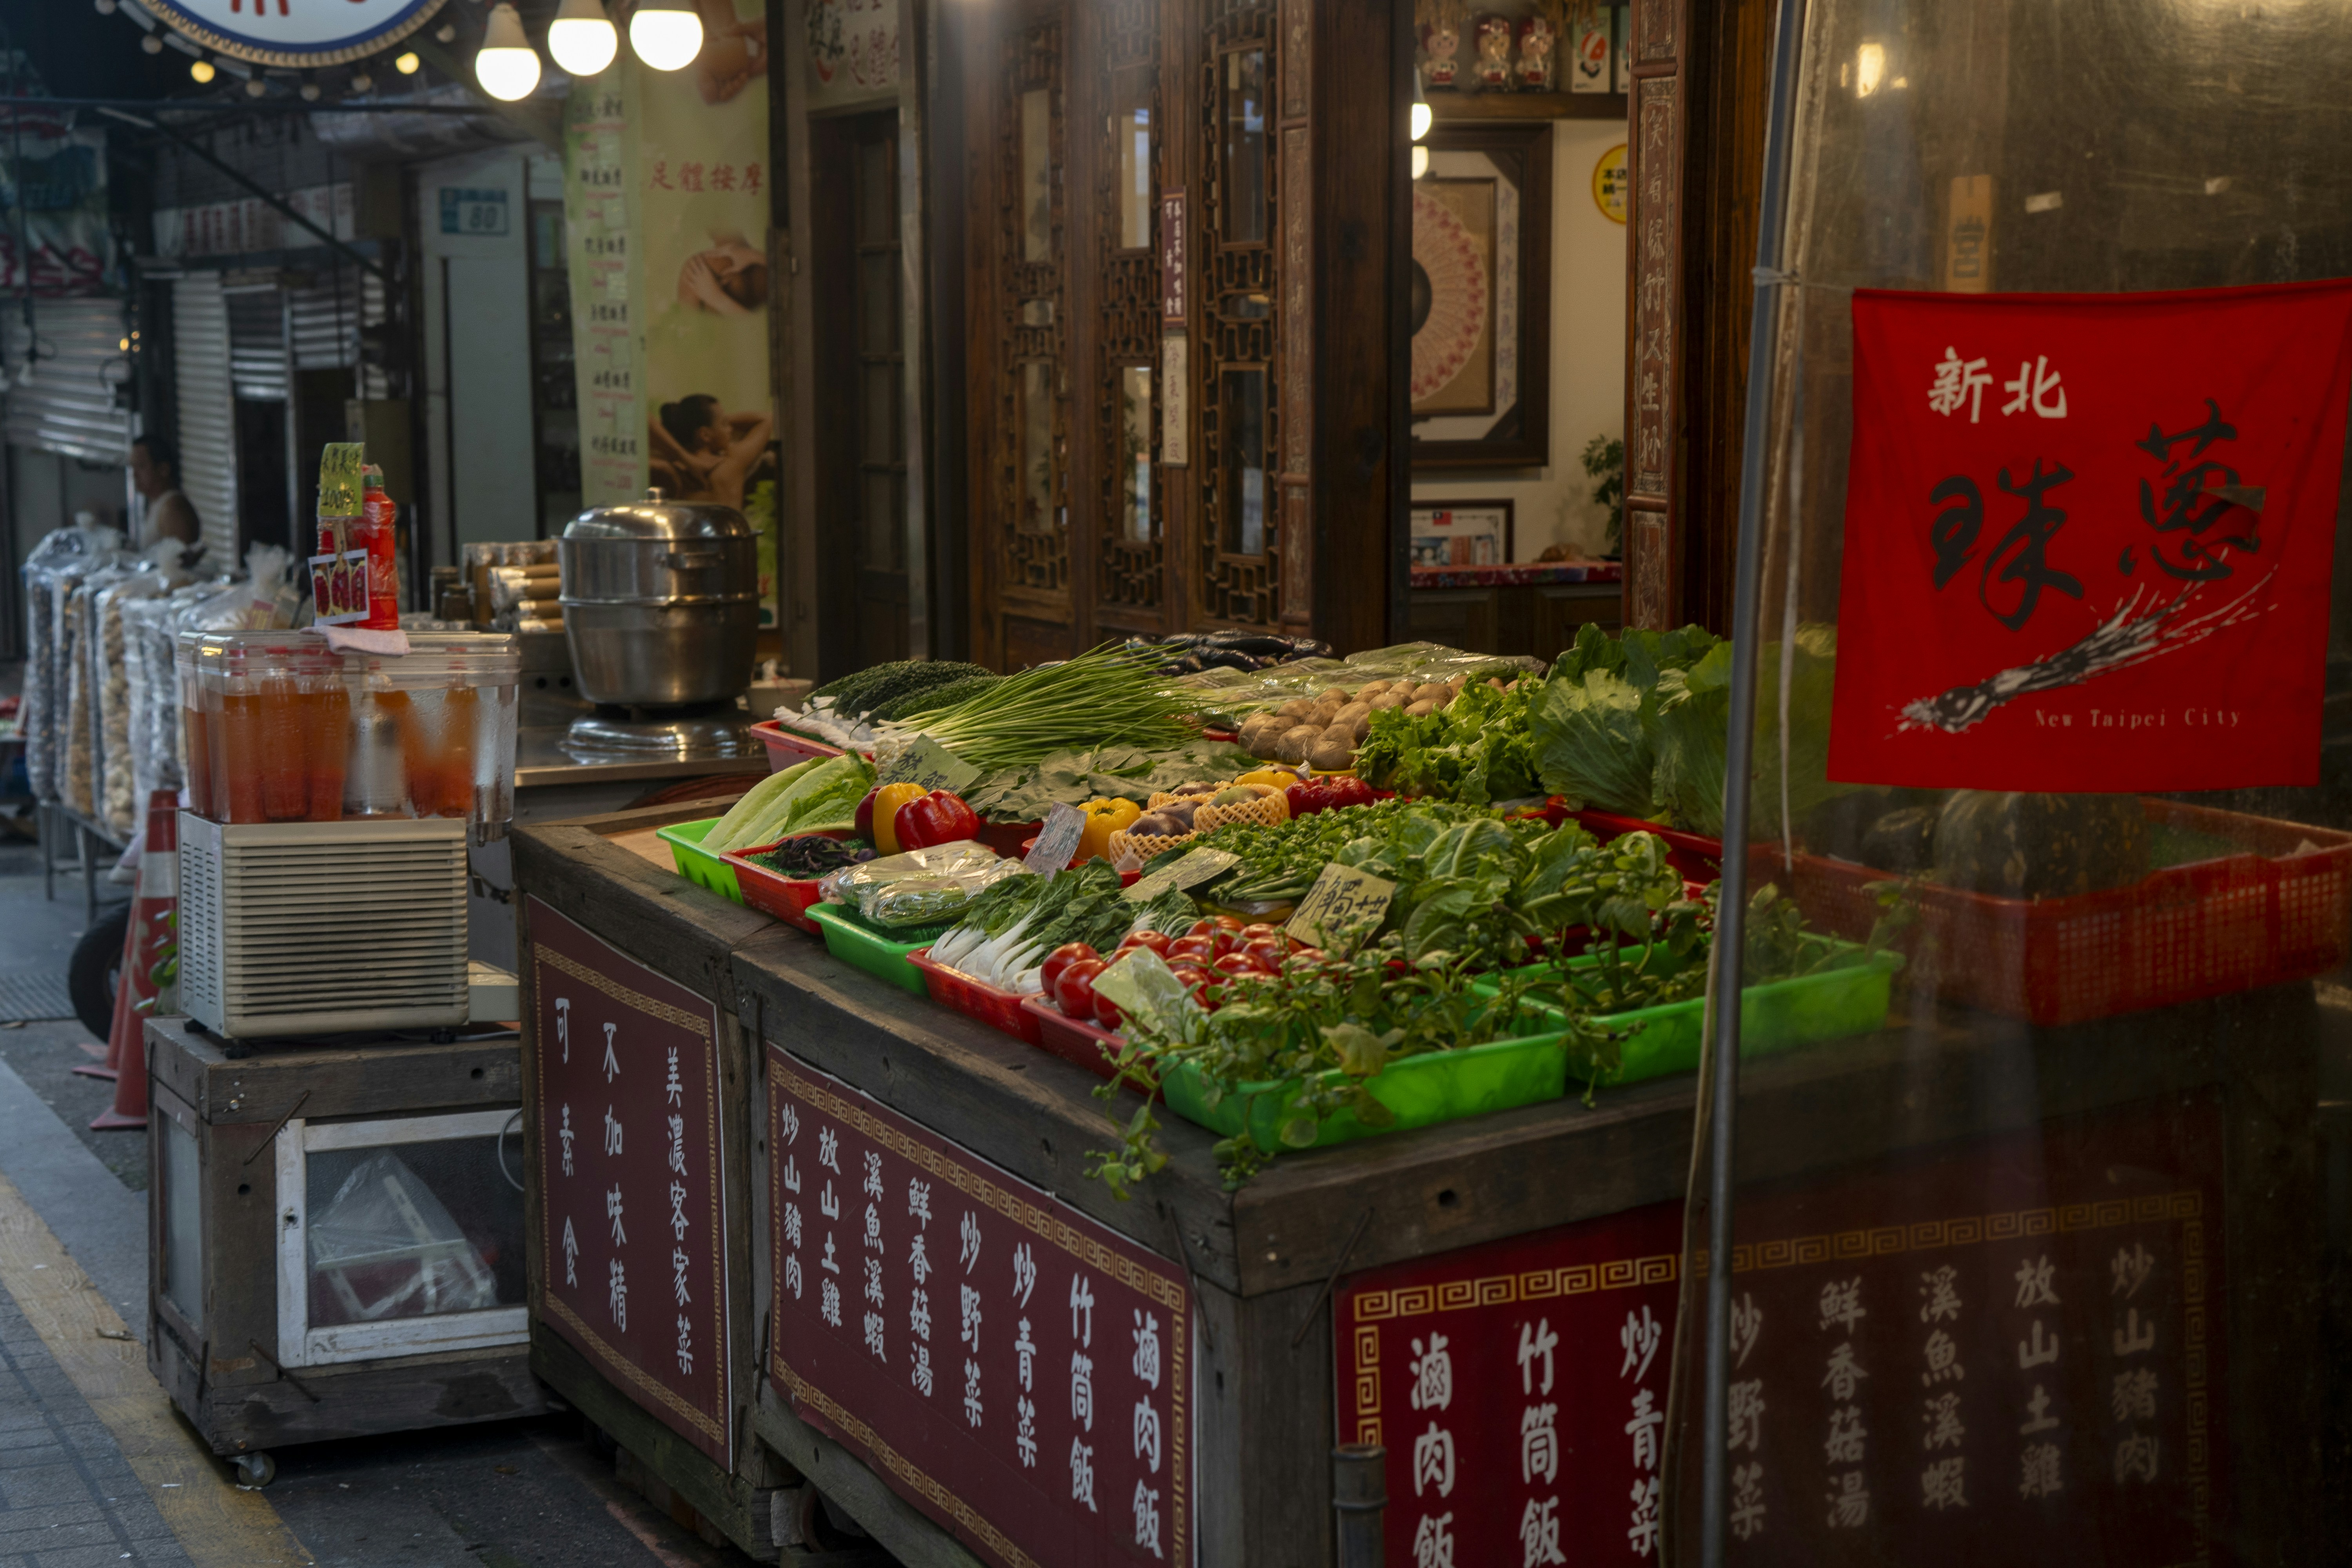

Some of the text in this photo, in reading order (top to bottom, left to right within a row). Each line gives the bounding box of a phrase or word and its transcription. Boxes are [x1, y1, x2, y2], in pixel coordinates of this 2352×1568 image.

[649, 160, 764, 195] 足體按摩
[1927, 345, 2068, 424] 新北
[2034, 707, 2242, 730] New Taipei City
[555, 997, 580, 1289] 可素食
[603, 1022, 628, 1334] 不加味精
[665, 1045, 693, 1376] 美濃客家菜
[782, 1102, 803, 1301] 炒山豬肉
[819, 1125, 843, 1328] 放山土雞
[863, 1149, 887, 1364] 溪魚溪蝦
[907, 1177, 934, 1397] 鮮香菇湯
[959, 1210, 984, 1429] 炒野菜
[1012, 1241, 1038, 1468] 炒青菜
[1069, 1272, 1098, 1514] 竹筒飯
[1818, 1275, 1870, 1529] 鮮香菇湯
[1919, 1264, 1970, 1511] 溪魚溪蝦
[2014, 1253, 2064, 1500] 放山土雞
[2109, 1241, 2160, 1486] 炒山豬肉
[1131, 1307, 1165, 1560] 滷肉飯
[1408, 1330, 1457, 1568] 滷肉飯
[1515, 1316, 1568, 1568] 竹筒飯
[1619, 1303, 1665, 1559] 炒青菜
[1728, 1290, 1767, 1542] 炒野菜
